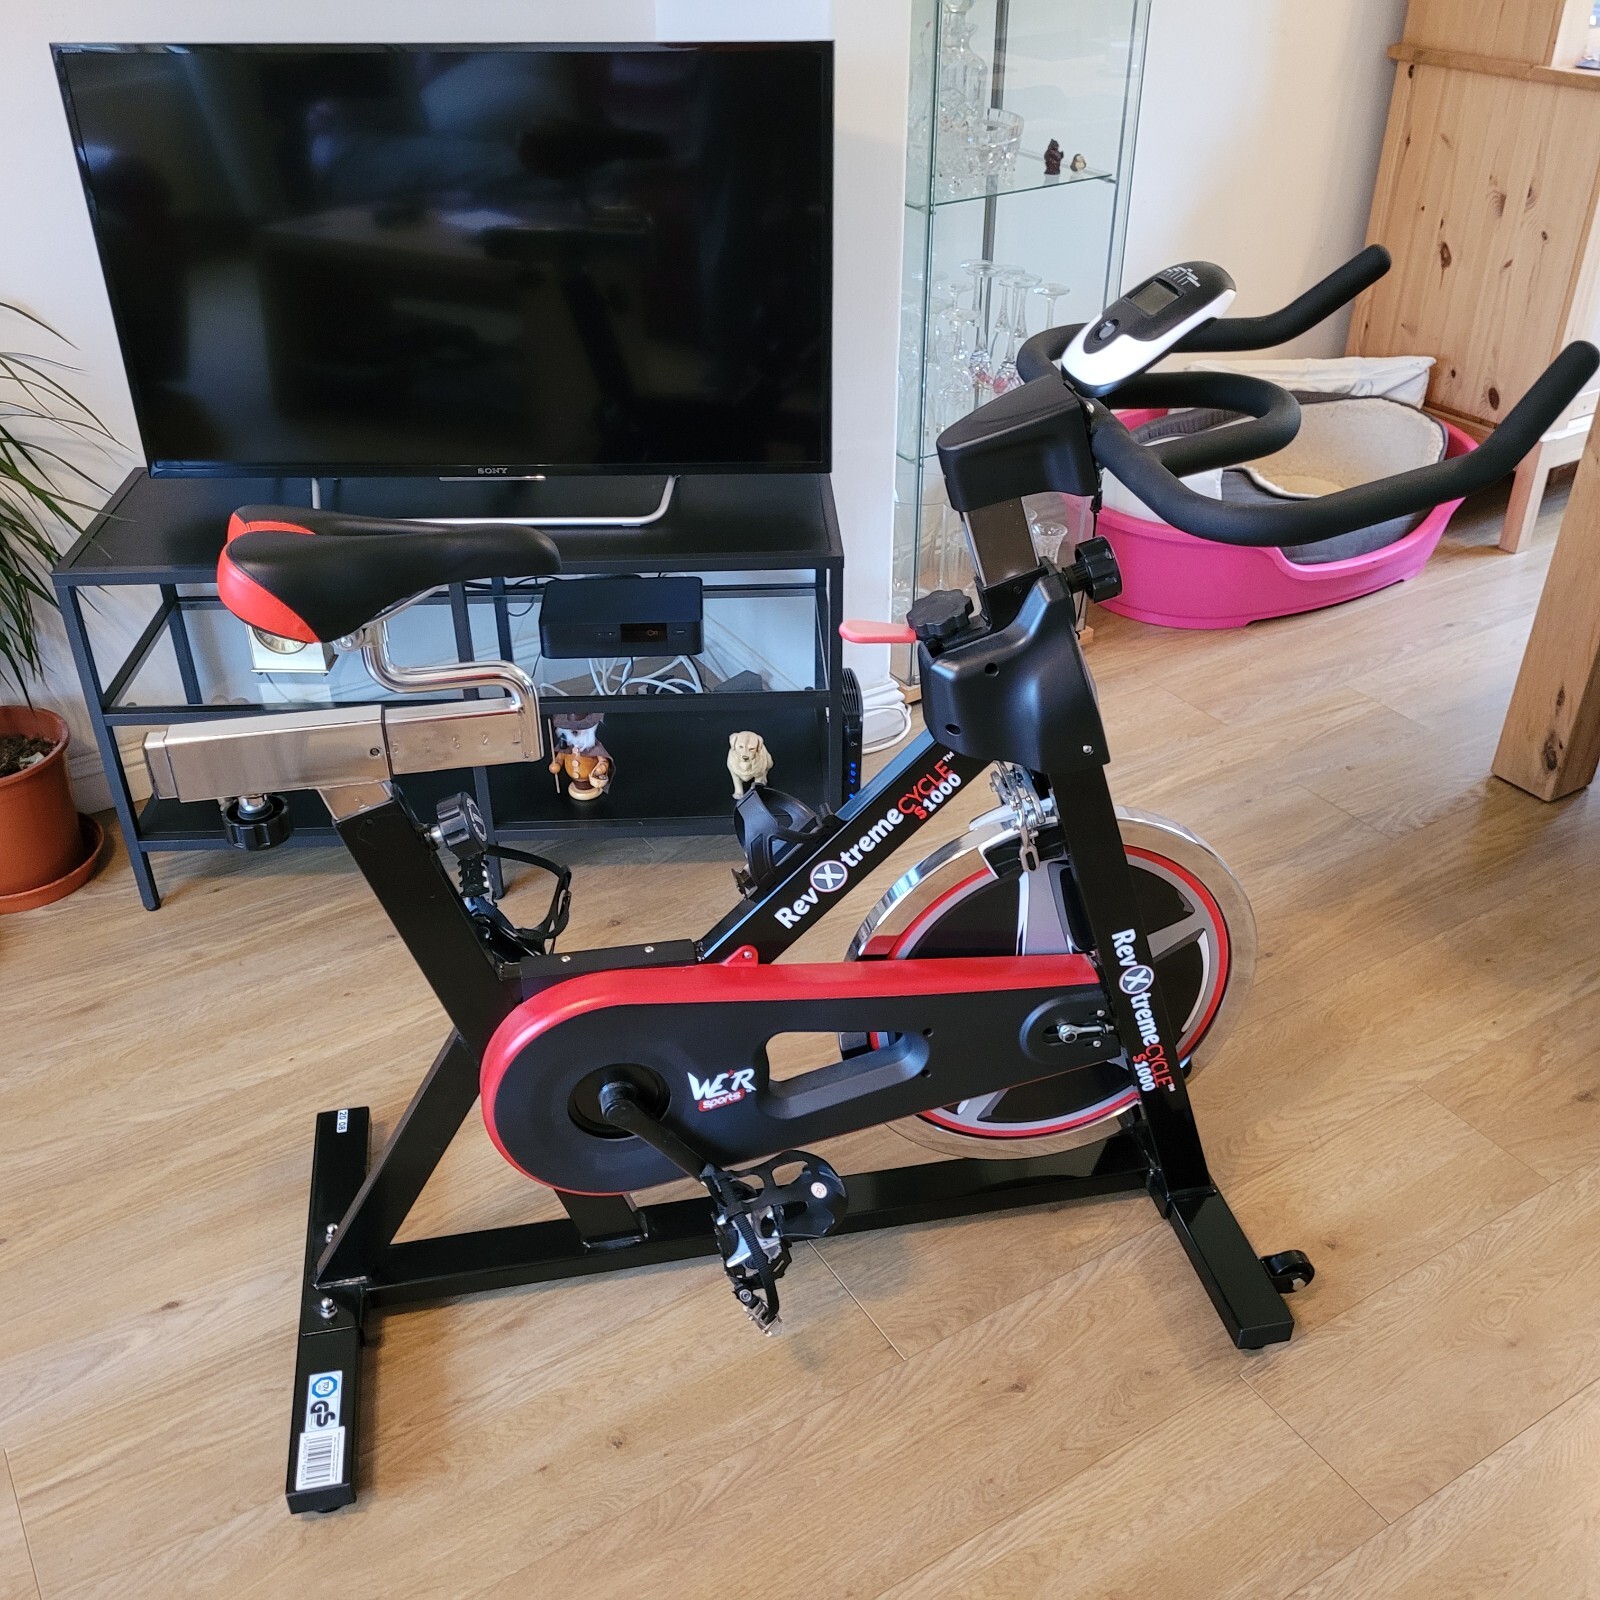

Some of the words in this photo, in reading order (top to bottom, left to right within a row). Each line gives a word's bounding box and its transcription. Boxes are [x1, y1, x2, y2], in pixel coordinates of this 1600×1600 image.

[477, 467, 508, 475] SONY
[914, 773, 962, 820] S1000
[1132, 1054, 1156, 1093] S1000
[702, 1091, 742, 1109] sports
[339, 1111, 347, 1120] 20
[310, 1400, 336, 1427] GS
